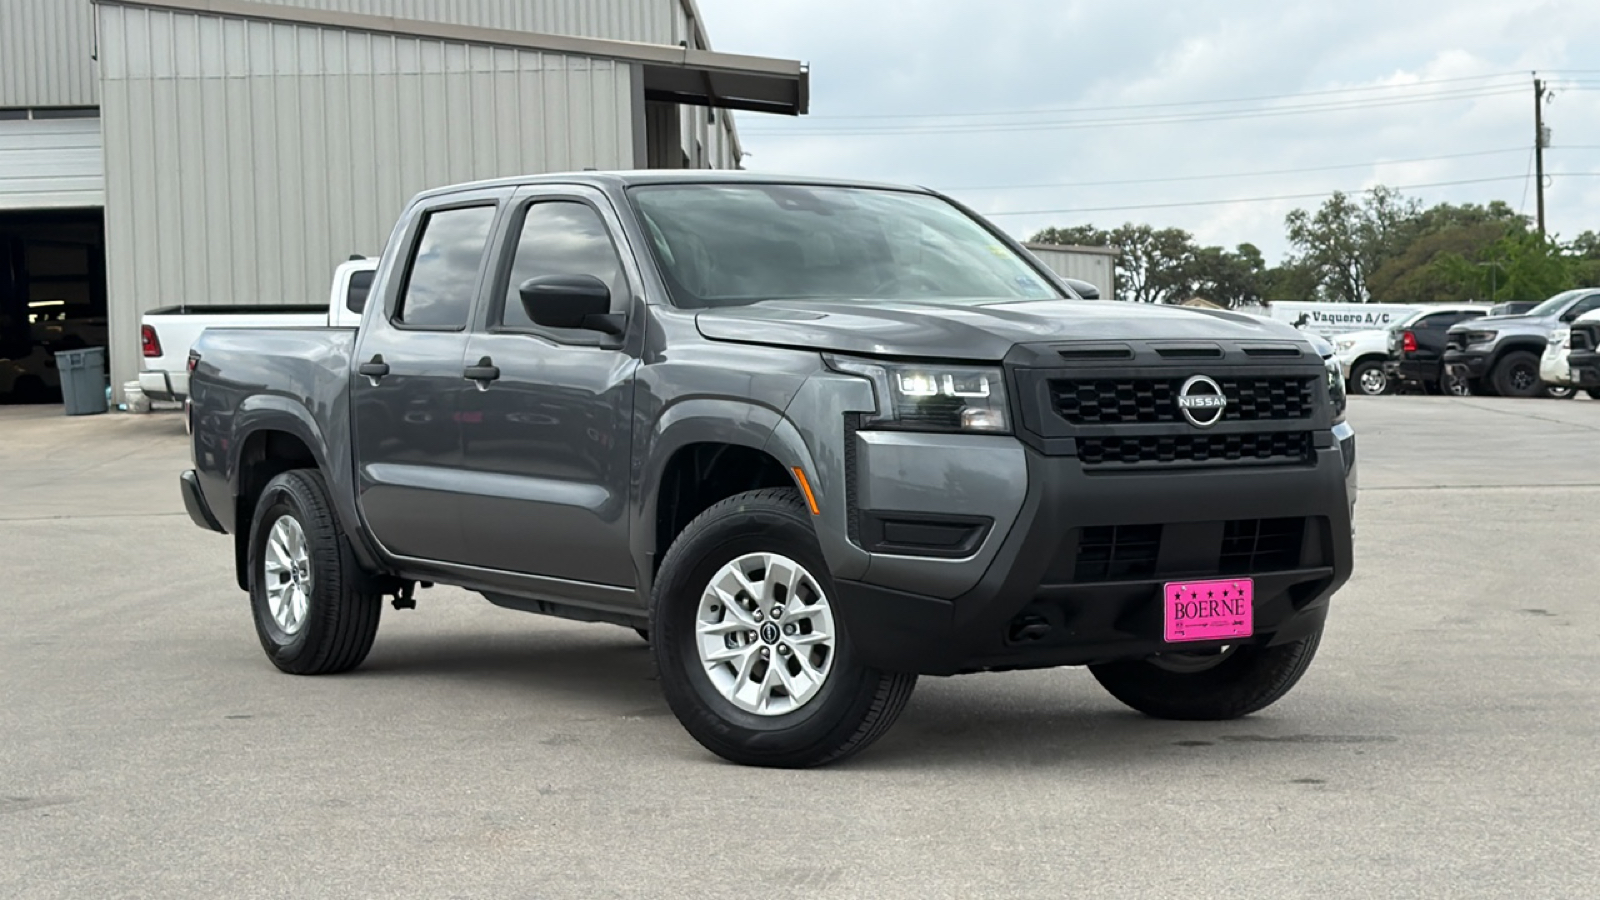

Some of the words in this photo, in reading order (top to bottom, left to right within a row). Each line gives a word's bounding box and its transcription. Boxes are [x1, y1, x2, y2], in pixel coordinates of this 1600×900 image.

[1312, 311, 1362, 324] Vaquero
[1365, 312, 1390, 325] A/C
[1179, 398, 1227, 407] NISSAN
[1174, 598, 1246, 620] BOERNE
